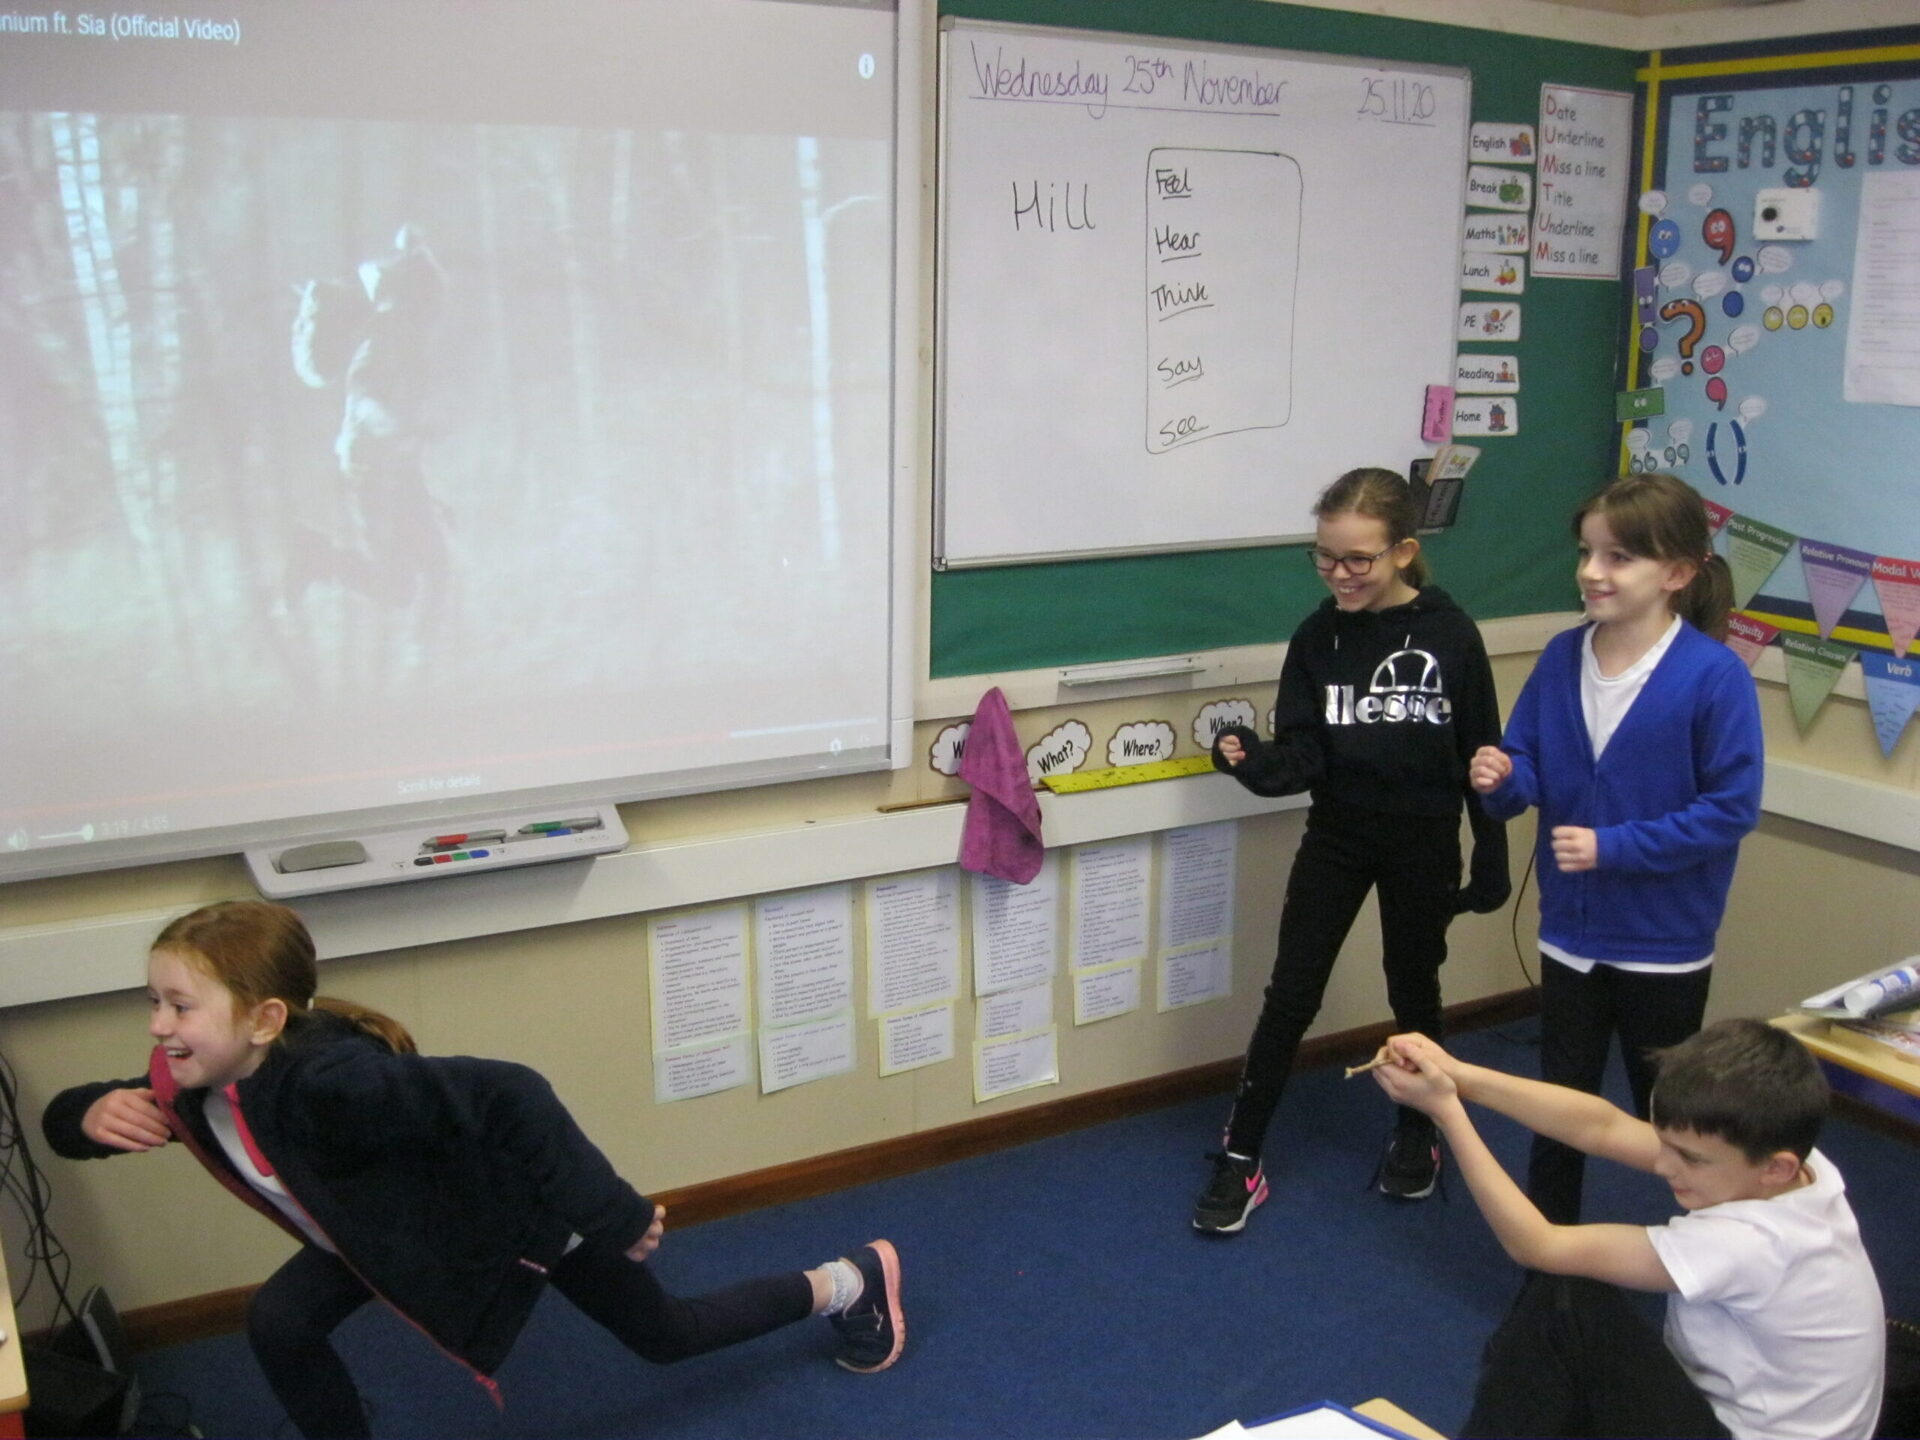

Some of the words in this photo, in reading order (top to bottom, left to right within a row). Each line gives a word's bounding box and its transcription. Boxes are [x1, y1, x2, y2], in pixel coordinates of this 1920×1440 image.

[54, 10, 72, 34] ft.
[78, 14, 105, 36] Sia
[111, 12, 179, 41] (Official
[184, 17, 241, 45] Video)
[971, 40, 1109, 120] Wednesday
[1122, 54, 1174, 95] 25th
[1184, 55, 1289, 107] November
[1358, 76, 1436, 121] 25.11.20
[1545, 95, 1576, 123] Date
[1473, 135, 1506, 153] English
[1545, 126, 1606, 150] Underline
[1542, 154, 1572, 176] Miss
[1575, 165, 1583, 176] a
[1584, 161, 1607, 178] line
[1155, 168, 1192, 197] Feel
[1470, 179, 1498, 194] Break
[1542, 182, 1574, 207] Title
[1012, 180, 1096, 232] Hill
[1466, 226, 1497, 241] Maths
[1539, 214, 1595, 238] Underline
[1156, 225, 1201, 255] Hear
[1536, 242, 1566, 263] Miss
[1569, 253, 1577, 263] a
[1578, 247, 1599, 265] line
[1463, 263, 1490, 278] Lunch
[1152, 282, 1208, 312] Think
[1464, 314, 1477, 328] PE
[1157, 356, 1203, 382] Say
[1458, 366, 1494, 382] Reading
[1456, 410, 1481, 423] Home
[1160, 415, 1209, 447] See
[1728, 519, 1746, 533] Past
[1747, 525, 1790, 548] Progressive
[1802, 545, 1834, 561] Relative
[1872, 561, 1907, 577] Modal
[1728, 617, 1765, 641] biguity
[1785, 638, 1816, 655] Relative
[1886, 662, 1912, 677] Verb
[1037, 740, 1074, 775] What?
[1123, 739, 1161, 757] Where?
